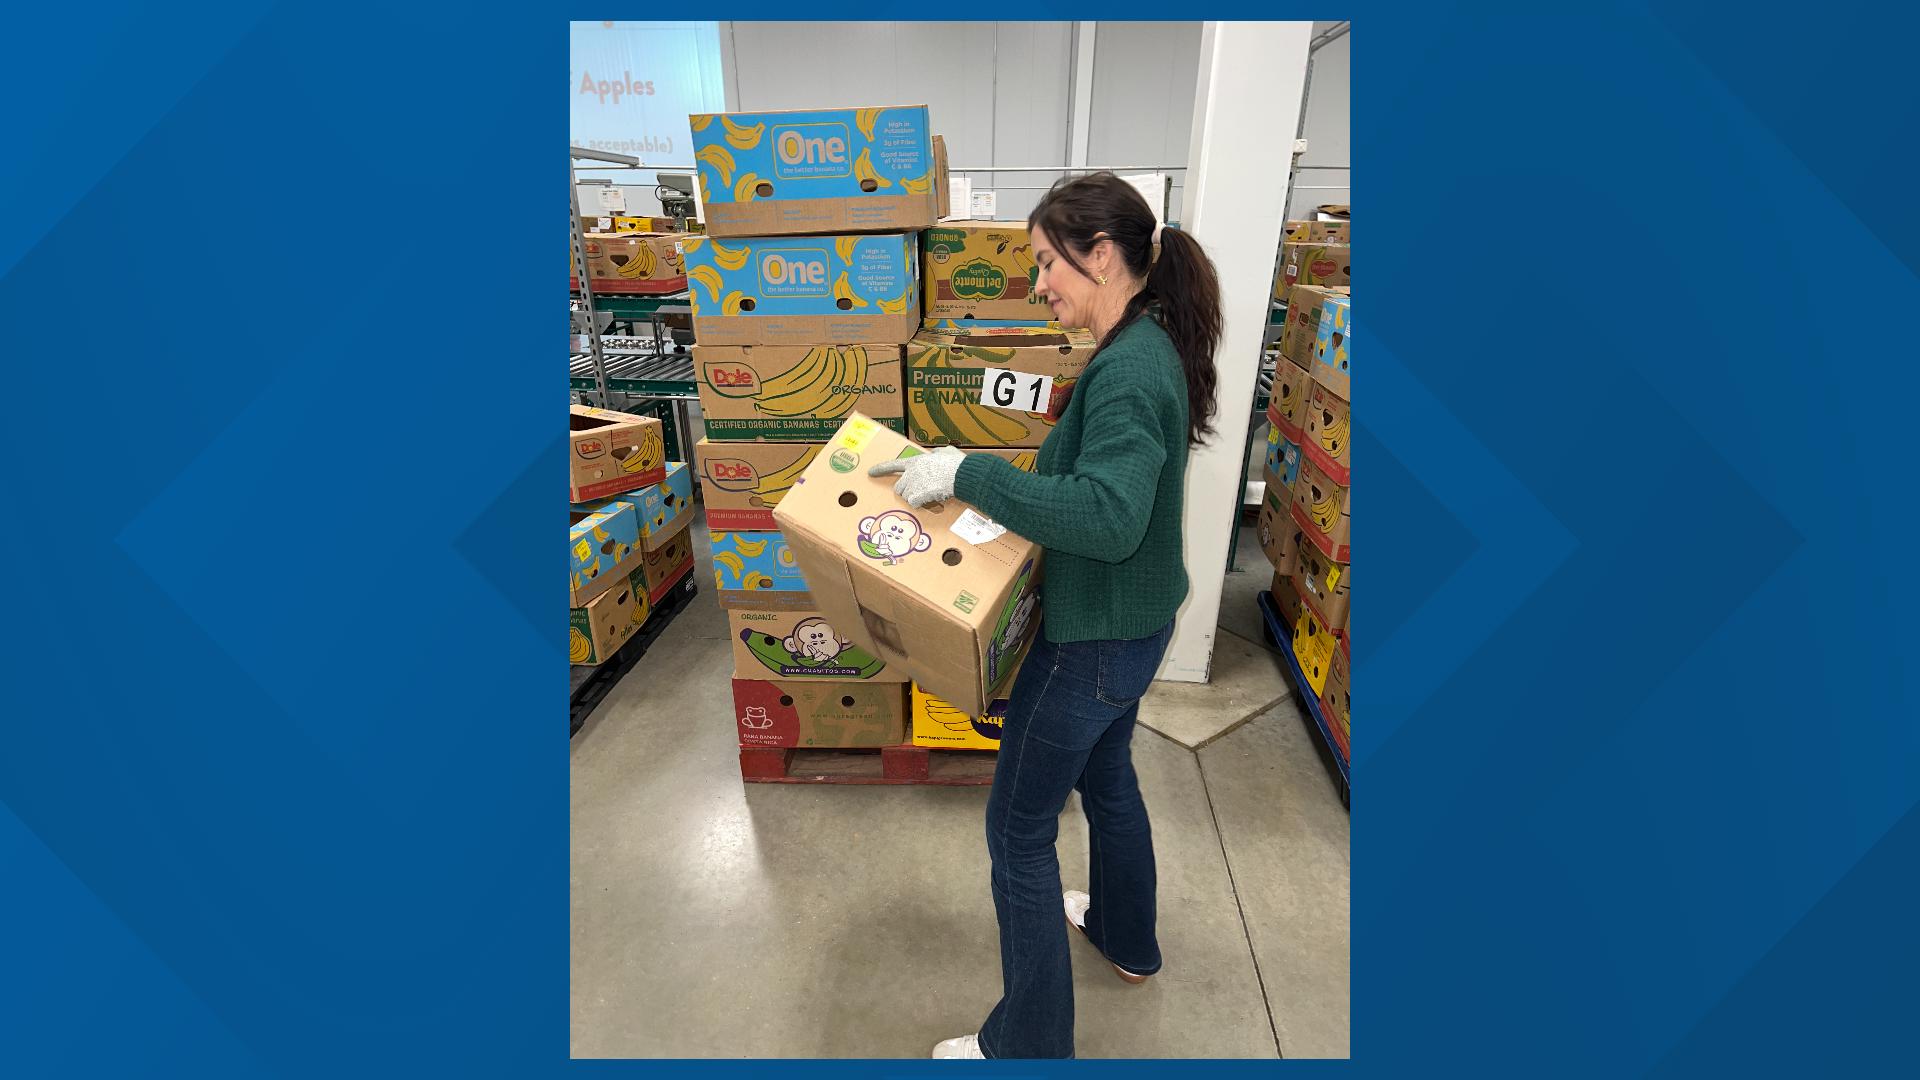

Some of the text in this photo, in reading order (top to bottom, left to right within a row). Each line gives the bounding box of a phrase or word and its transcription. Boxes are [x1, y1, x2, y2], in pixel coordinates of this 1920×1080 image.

[580, 70, 655, 104] Apples
[589, 135, 673, 154] acceptable)
[778, 130, 845, 165] One
[763, 254, 826, 286] One
[955, 277, 1001, 288] Del Monte
[712, 368, 753, 384] Dole
[913, 370, 985, 385] Premium
[831, 384, 896, 396] ORGANIC
[993, 371, 1043, 411] G 1
[710, 420, 747, 429] CERTIFIED
[749, 420, 782, 429] ORGANIC
[784, 420, 820, 429] BANANAS
[713, 463, 752, 479] Dole
[740, 613, 778, 621] ORGANIC
